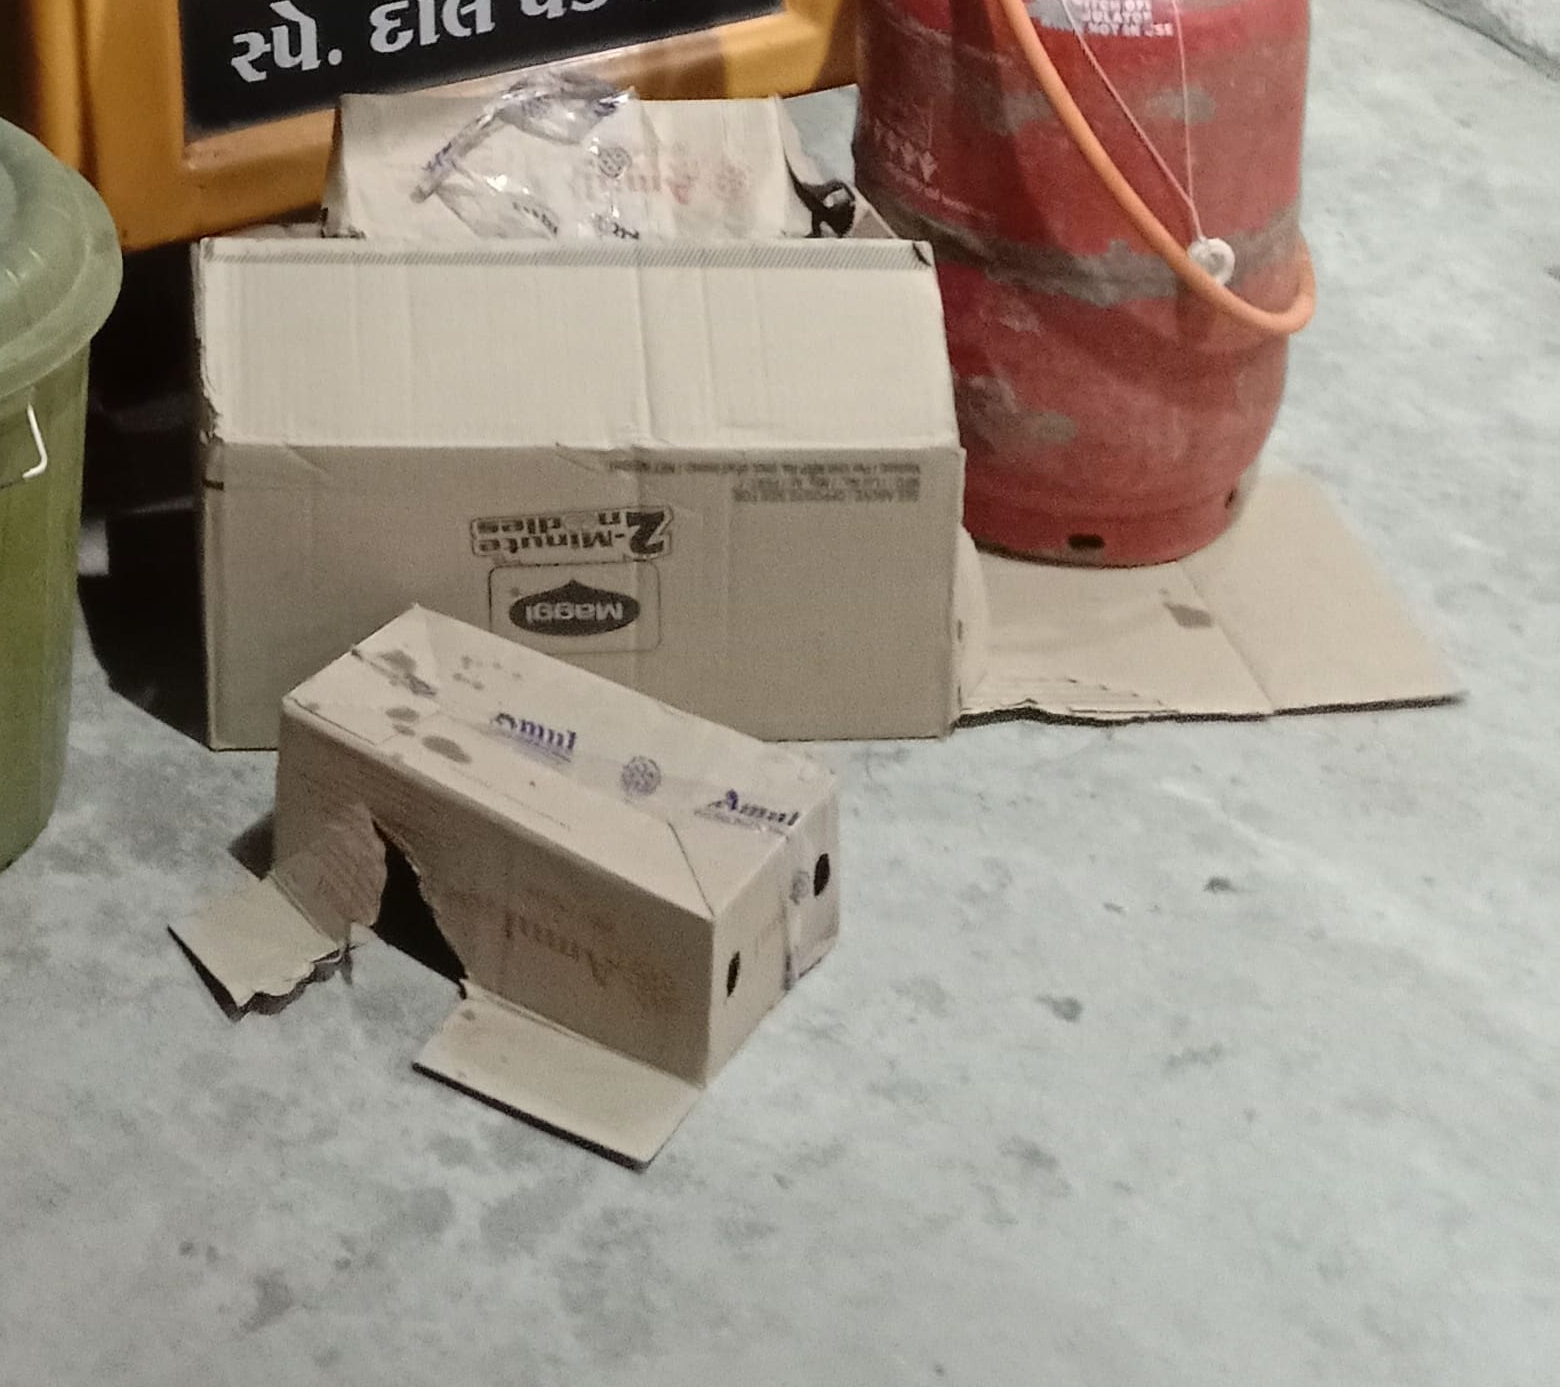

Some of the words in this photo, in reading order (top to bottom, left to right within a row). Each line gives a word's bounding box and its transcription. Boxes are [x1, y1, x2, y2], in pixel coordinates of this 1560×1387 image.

[230, 0, 341, 82] સ્પે.
[525, 601, 624, 623] Maggi
[704, 788, 800, 827] Amul
